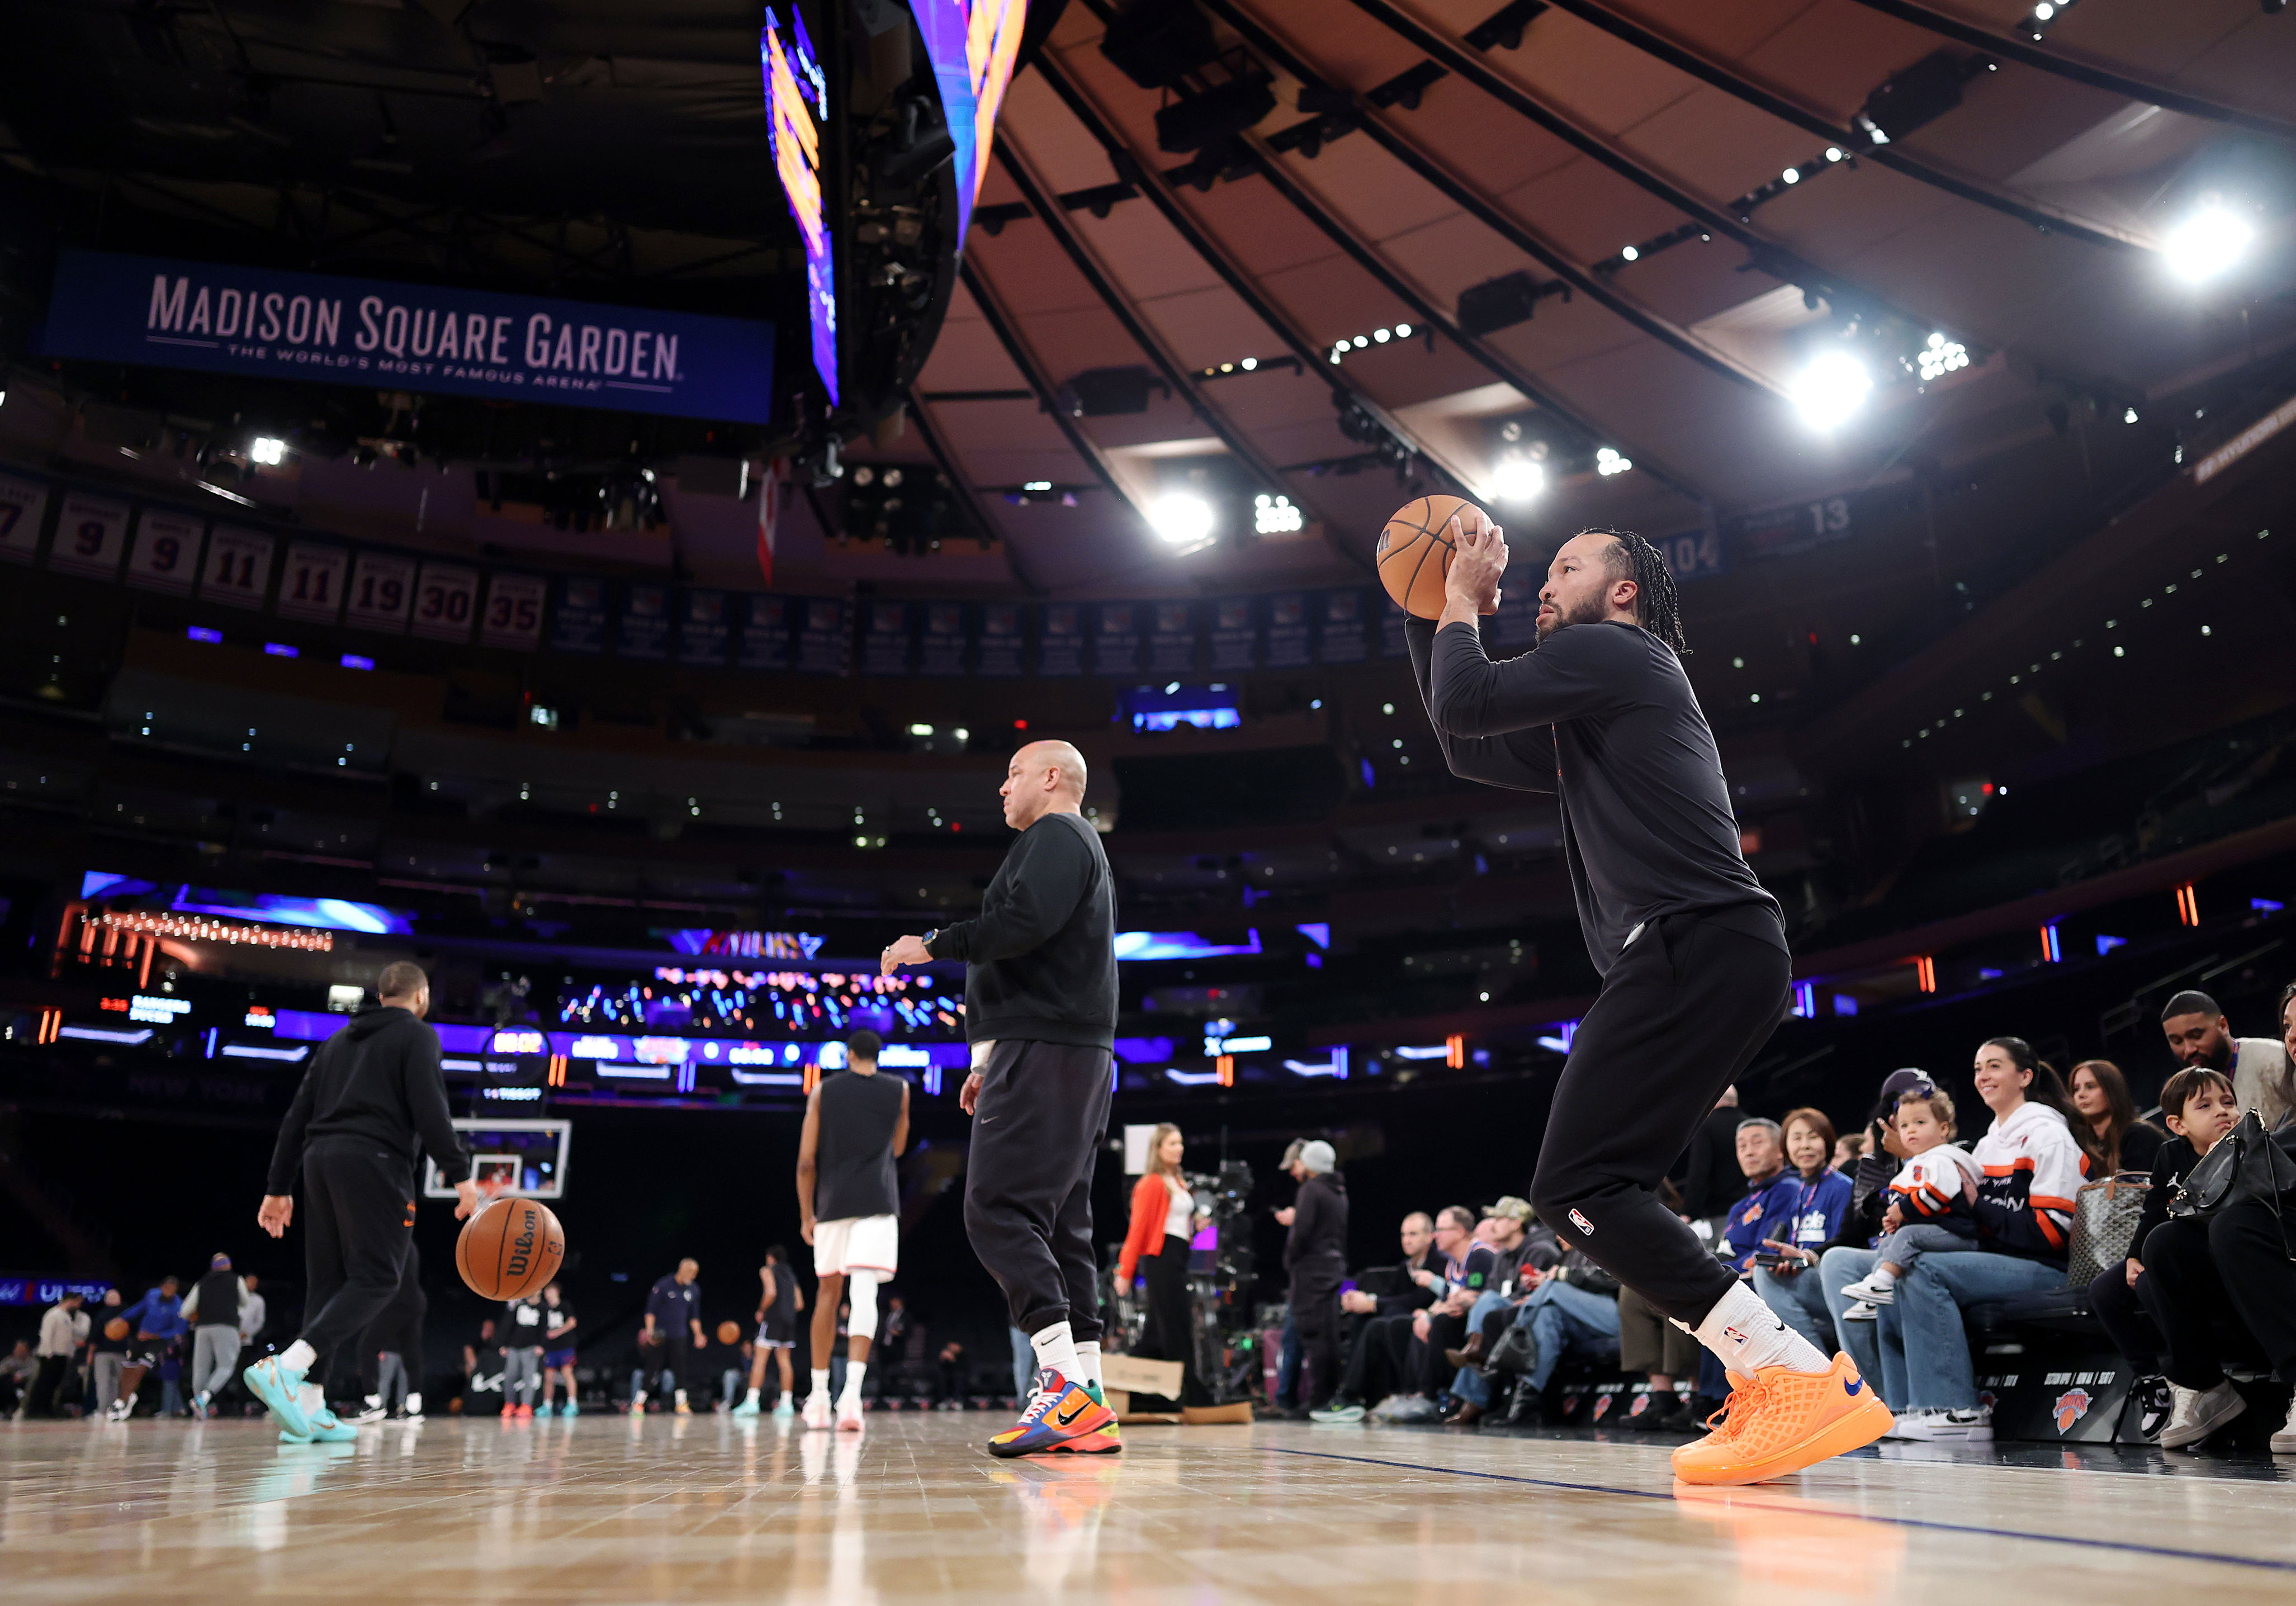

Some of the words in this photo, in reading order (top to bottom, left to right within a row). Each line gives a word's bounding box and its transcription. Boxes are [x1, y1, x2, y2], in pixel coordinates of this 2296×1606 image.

[227, 343, 268, 360] THE
[276, 349, 370, 370] WORLD'S
[378, 358, 436, 375] MOST
[443, 364, 526, 385] FAMOUS
[532, 373, 602, 391] ARENA
[75, 522, 105, 556] 9
[152, 538, 179, 572] 9
[215, 551, 255, 588] 11
[292, 567, 330, 603] 11
[358, 577, 403, 612] 19
[422, 587, 470, 623] 30
[490, 595, 538, 631] 35
[506, 1210, 536, 1276] Wilson
